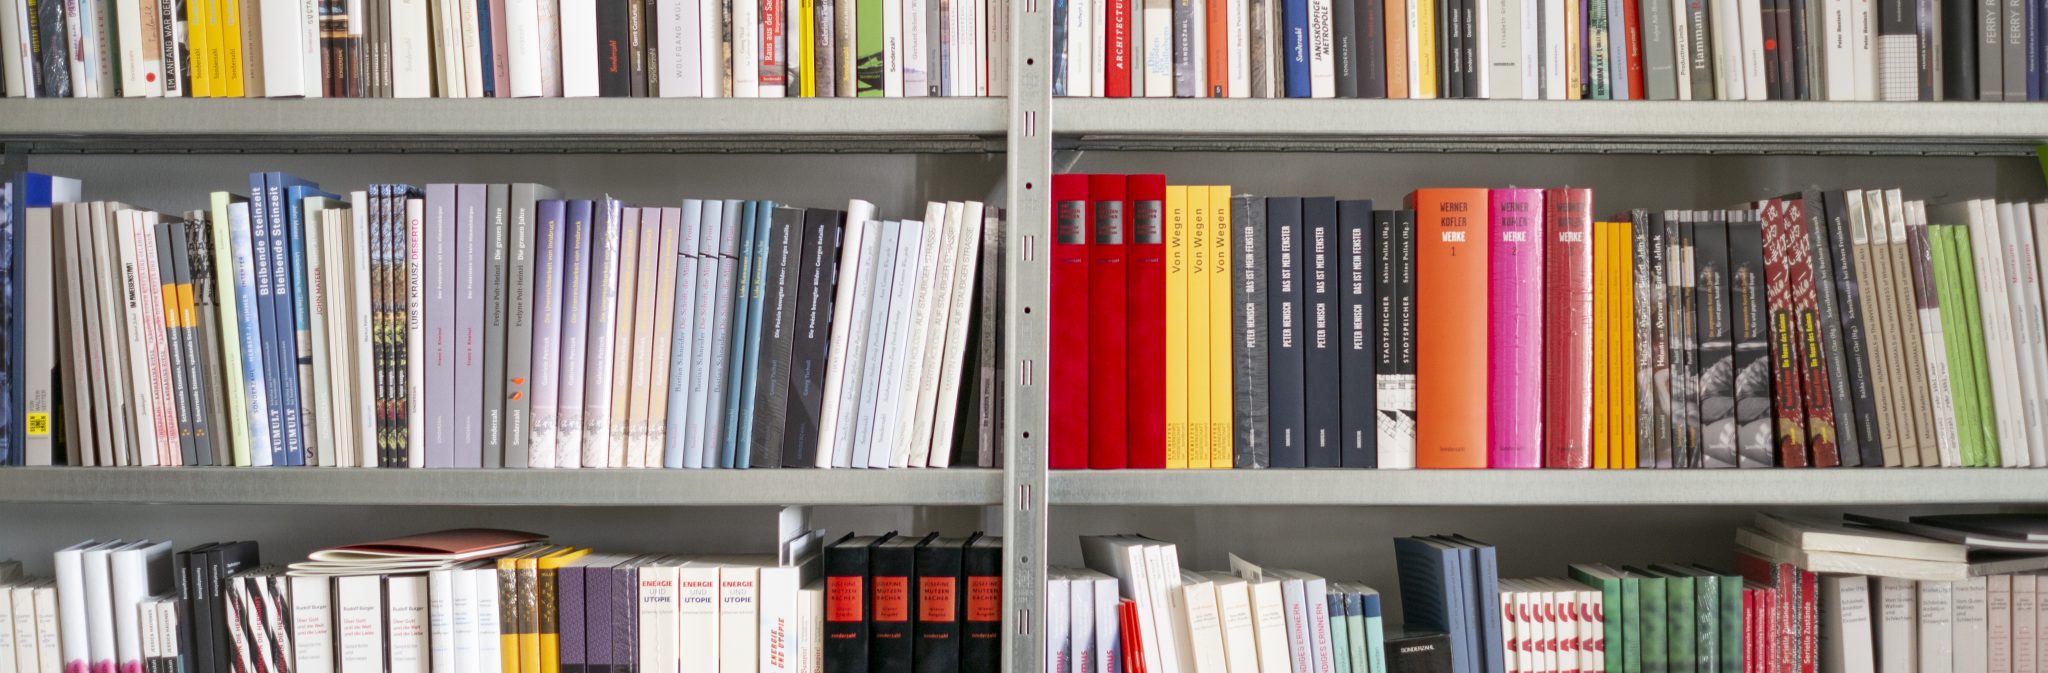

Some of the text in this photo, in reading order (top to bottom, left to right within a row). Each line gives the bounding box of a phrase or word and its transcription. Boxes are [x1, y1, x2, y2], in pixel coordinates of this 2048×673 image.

[164, 18, 172, 37] WAR
[1116, 0, 1124, 69] ARCHITECTU
[1295, 28, 1303, 62] Sonderzahl
[1321, 6, 1329, 55] METROPOLE
[1693, 11, 1705, 69] Hammam
[1985, 11, 1997, 44] FERRY
[2010, 11, 2021, 45] FERRY
[166, 40, 175, 75] ANFANG
[194, 48, 202, 79] Sonderzahl
[212, 48, 220, 79] Sonderzahl
[609, 40, 618, 72] Sonderzahl
[650, 48, 658, 83] Sonderzahl
[675, 26, 683, 78] WOLFGANG
[168, 78, 176, 89] IM
[252, 187, 264, 236] Steinzeit
[269, 186, 282, 236] Steinzeit
[495, 208, 503, 226] Jahre
[518, 208, 526, 226] Jahre
[1440, 202, 1468, 212] WERNER
[1441, 217, 1467, 226] KOFLER
[1501, 202, 1529, 212] WERNER
[411, 219, 419, 260] DESERTO
[496, 227, 504, 248] grauen
[1171, 208, 1183, 273] Von Wegen
[1193, 208, 1205, 273] Von Wegen
[1215, 208, 1227, 273] Von Wegen
[1382, 221, 1390, 239] (Hg.)
[1402, 221, 1410, 239] (Hg.)
[1442, 231, 1466, 242] WERKE
[1503, 232, 1527, 242] WERKE
[1559, 232, 1583, 242] WERKE
[257, 240, 269, 295] Bleibende
[273, 240, 286, 295] Bleibende
[781, 246, 789, 266] Georges
[815, 247, 823, 266] Georges
[314, 267, 322, 294] MATEER
[411, 262, 419, 298] KRAUSZ
[1245, 226, 1255, 348] PETER HENISCH DAS IST MEIN FENSTER
[1281, 226, 1292, 347] PETER HENISCH DAS IST MEIN FENSTER
[1315, 226, 1326, 348] PETER HENISCH DAS IST MEIN FENSTER
[1352, 228, 1363, 350] PETER HENISCH DAS IST MEIN FENSTER
[411, 310, 419, 330] LUIS
[493, 304, 502, 326] Evelyne
[516, 304, 524, 327] Evelyne
[1402, 296, 1410, 364] STADTSPEICHER
[270, 409, 282, 452] TUMULT
[286, 408, 298, 452] TUMULT
[490, 409, 498, 445] Sonderzahl
[513, 409, 521, 446] Sonderzahl
[1293, 604, 1304, 644] ERINNERN
[1315, 603, 1326, 643] ERINNERN
